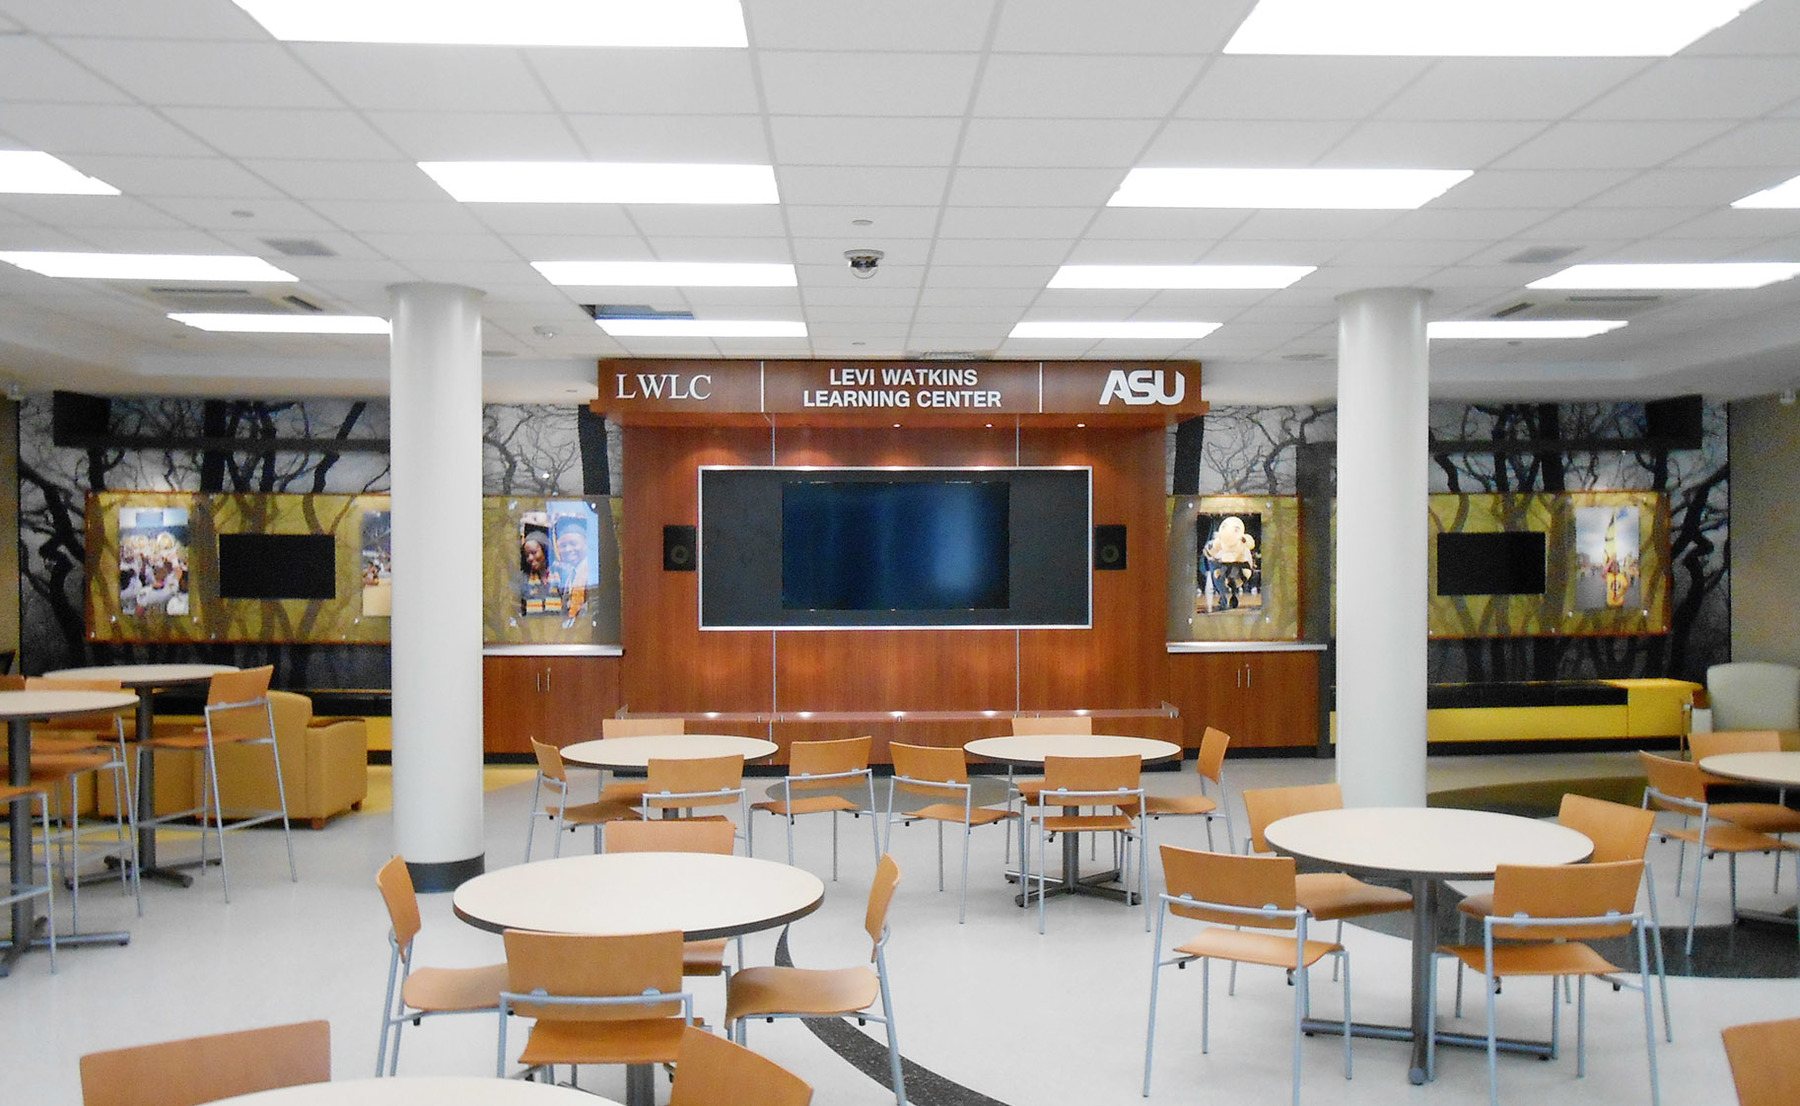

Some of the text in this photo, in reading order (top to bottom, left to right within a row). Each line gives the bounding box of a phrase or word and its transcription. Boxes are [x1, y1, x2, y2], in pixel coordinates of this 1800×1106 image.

[616, 373, 712, 400] LWLC
[829, 368, 978, 386] LEVI WATKINS
[1098, 369, 1185, 407] ASU
[803, 390, 1003, 409] LEARNING CENTER
